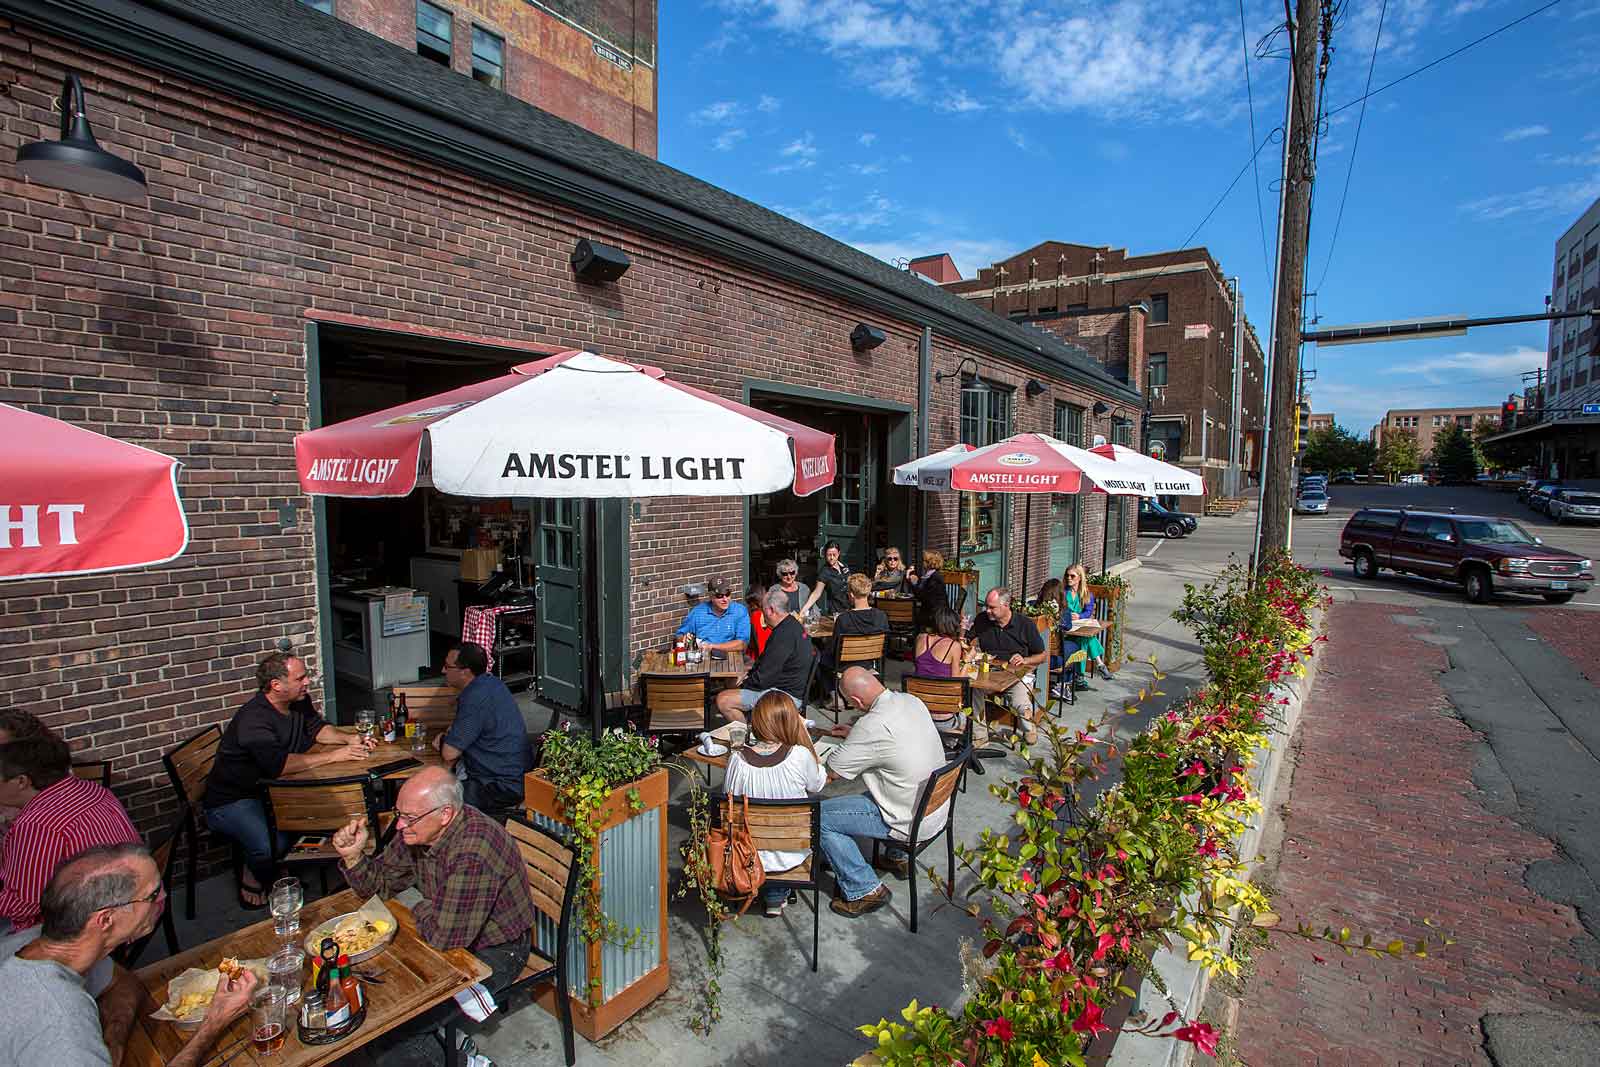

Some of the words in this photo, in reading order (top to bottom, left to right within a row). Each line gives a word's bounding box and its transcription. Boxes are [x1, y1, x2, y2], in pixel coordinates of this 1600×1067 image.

[306, 458, 351, 482] AMSTEL
[351, 458, 400, 483] LIGHT
[641, 456, 745, 480] LIGHT
[969, 473, 1015, 484] AMSTEL
[1017, 474, 1059, 485] LIGHT
[1127, 481, 1146, 492] LIGHT
[1165, 482, 1190, 490] LIGHT
